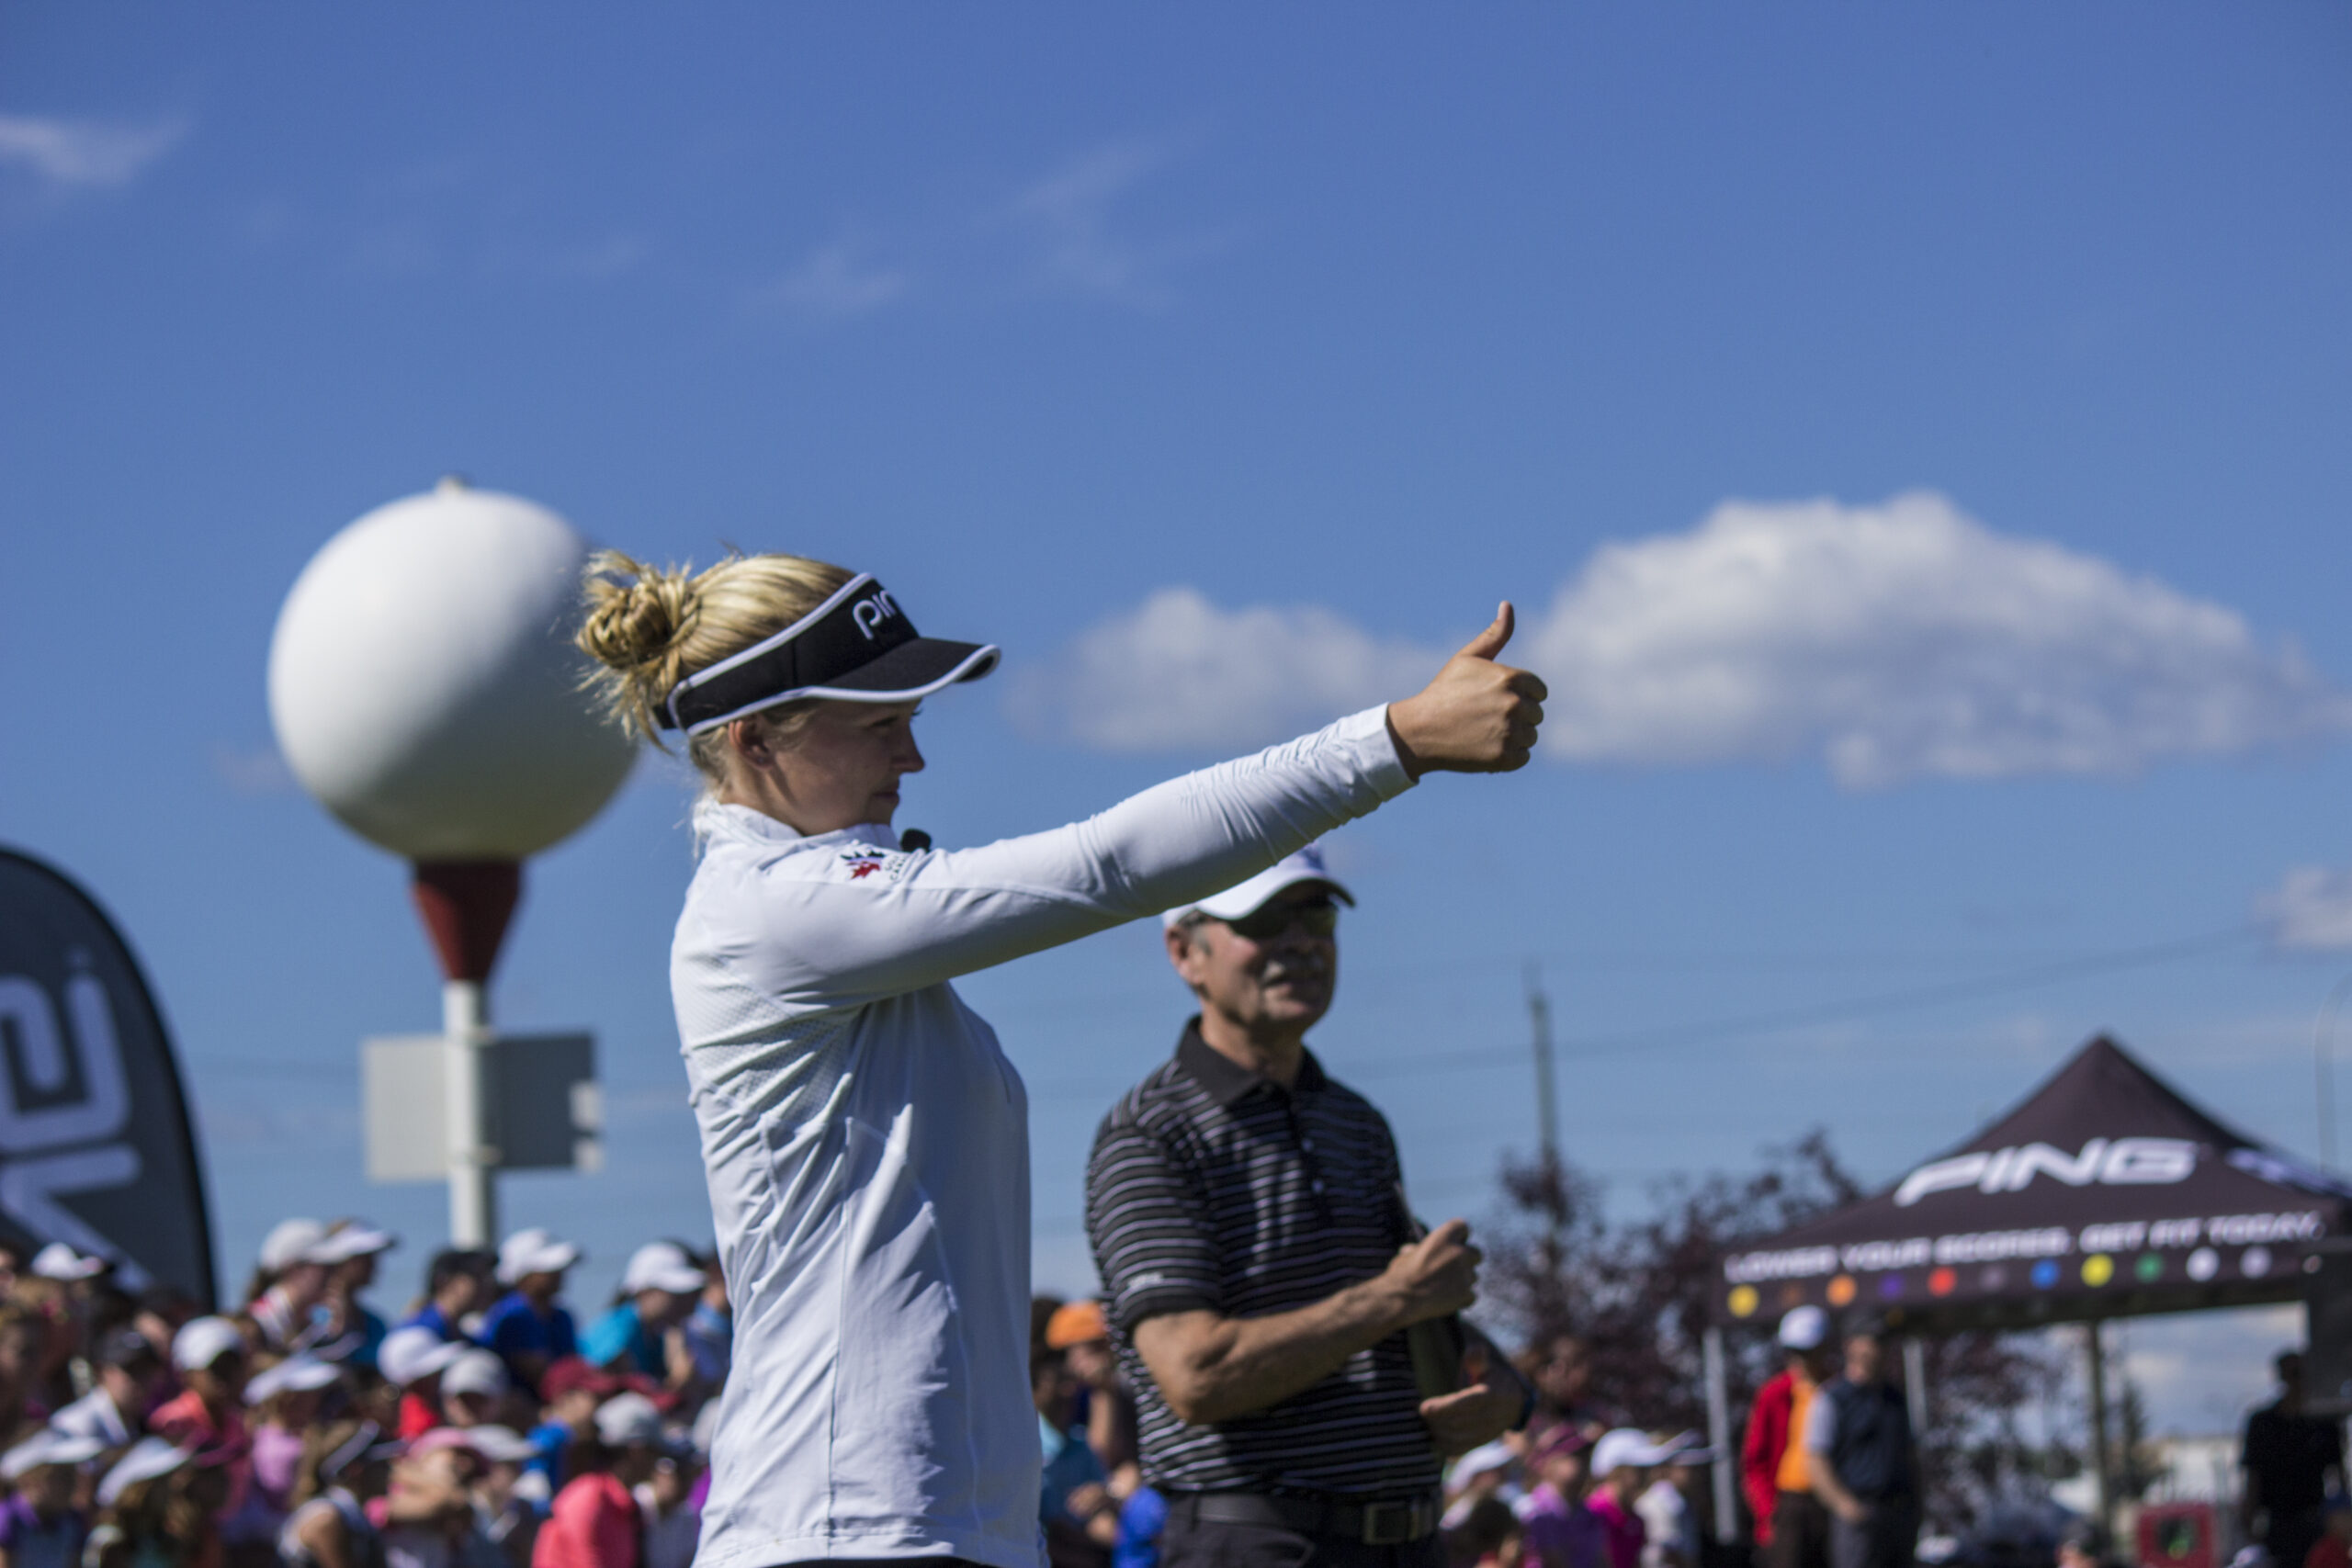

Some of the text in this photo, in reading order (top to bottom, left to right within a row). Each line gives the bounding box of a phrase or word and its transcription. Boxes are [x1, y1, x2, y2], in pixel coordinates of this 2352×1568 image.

[1893, 1137, 2197, 1207] PING
[1724, 1246, 1838, 1284] LOWER
[1840, 1237, 1930, 1271] YOUR
[2078, 1221, 2147, 1253] GET
[2148, 1216, 2202, 1248] FIT
